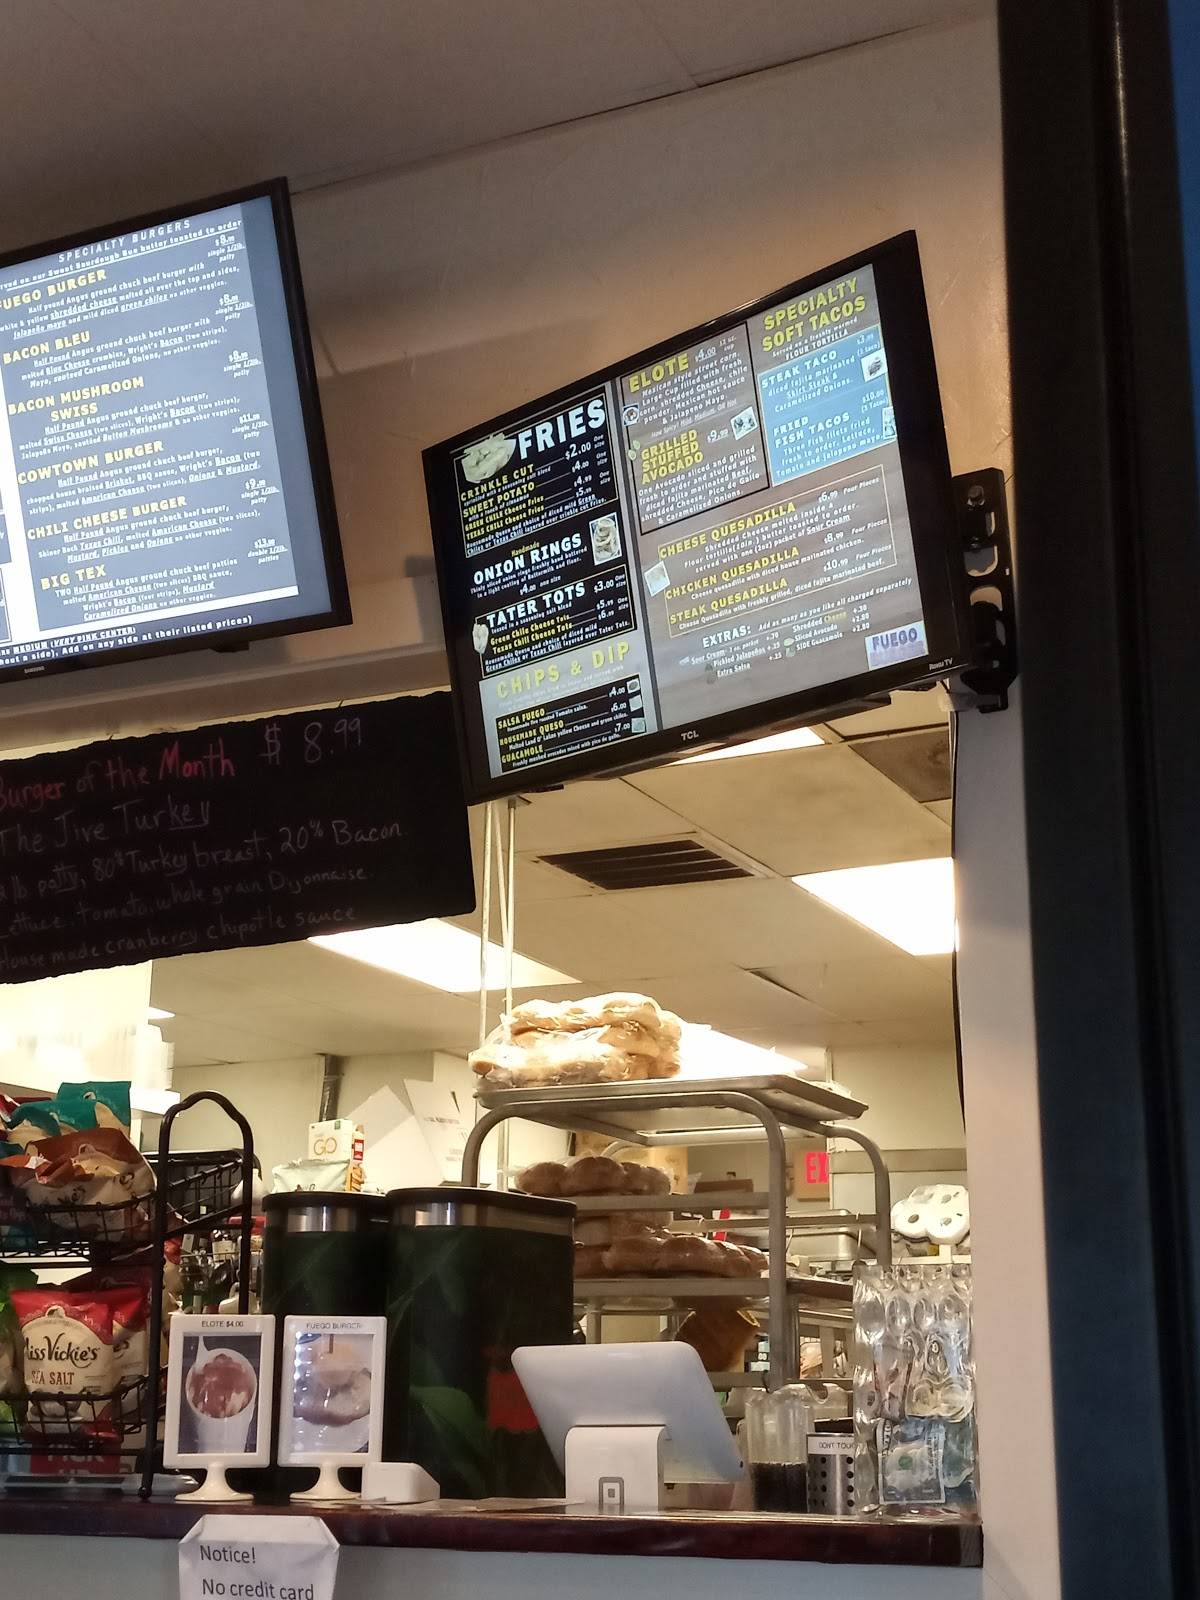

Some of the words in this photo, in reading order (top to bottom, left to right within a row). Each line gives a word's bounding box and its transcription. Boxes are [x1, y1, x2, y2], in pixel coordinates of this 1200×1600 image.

[59, 238, 124, 264] SPECIALTY
[132, 220, 190, 244] BURGERS
[0, 290, 41, 310] UEGO
[47, 270, 106, 296] BURGER
[765, 278, 856, 331] SPECIALTY
[762, 322, 803, 352] SOFT
[809, 296, 865, 333] TACOS
[812, 329, 848, 350] TORTILLA
[3, 342, 49, 365] BACON
[55, 331, 90, 351] BLEU
[630, 353, 688, 393] ELOTE
[642, 381, 671, 399] Mexican
[674, 371, 692, 385] style
[694, 360, 717, 376] street
[642, 394, 662, 407] Large
[665, 387, 678, 397] Cup
[681, 375, 701, 390] filled
[703, 368, 720, 381] with
[722, 358, 742, 373] fresh
[661, 388, 694, 408] shredded
[729, 366, 747, 379] chile
[762, 365, 800, 389] STEAK
[804, 350, 836, 371] TACO
[8, 396, 55, 416] BACON
[61, 376, 144, 404] MUSHROOM
[675, 393, 705, 411] Mexican
[708, 386, 720, 397] hot
[723, 376, 745, 391] sauce
[51, 402, 98, 423] SWISS
[519, 400, 605, 459] FRIES
[774, 417, 808, 438] FRIED
[775, 429, 804, 449] FISH
[809, 412, 849, 435] TACOS
[18, 455, 98, 485] COWTOWN
[105, 441, 163, 464] BURGER
[641, 430, 697, 461] GRILLED
[643, 441, 698, 473] STUFFED
[461, 475, 508, 502] CRINKLE
[513, 464, 533, 480] CUT
[565, 442, 591, 460] $2.00
[638, 487, 652, 497] One
[655, 474, 685, 491] Avocado
[688, 463, 710, 478] sliced
[713, 457, 726, 469] and
[729, 445, 755, 463] grilled
[639, 493, 658, 506] fresh
[661, 490, 668, 498] to
[671, 480, 690, 494] order
[694, 473, 707, 485] and
[710, 461, 737, 479] stuffed
[739, 454, 757, 467] with
[642, 452, 703, 486] AVOCADO
[463, 498, 493, 518] SWEET
[497, 482, 534, 505] POTATO
[646, 498, 665, 513] diced
[691, 474, 729, 495] marinated
[27, 521, 68, 540] CHILI
[74, 508, 127, 530] CHEESE
[132, 496, 186, 517] BURGER
[658, 534, 706, 561] CHEESE
[711, 502, 795, 542] QUESADILLA
[41, 573, 70, 590] BIG
[75, 564, 106, 582] TEX
[474, 555, 524, 585] ONION
[530, 533, 581, 565] RINGS
[664, 575, 717, 601] CHICKEN
[722, 547, 799, 581] QUESADILLA
[487, 600, 537, 628] TATER
[543, 582, 585, 609] TOTS
[594, 579, 614, 594] $3.00
[670, 604, 706, 625] STEAK
[711, 578, 787, 611] QUESADILLA
[62, 645, 79, 655] Add
[83, 644, 94, 652] on
[98, 640, 114, 649] any
[118, 636, 138, 646] side
[142, 633, 152, 642] at
[155, 629, 180, 639] their
[183, 622, 212, 634] listed
[490, 635, 510, 646] Green
[512, 627, 529, 639] Chile
[530, 619, 555, 633] Cheese
[556, 614, 570, 624] Tots
[703, 625, 751, 648] EXTRAS:
[871, 623, 919, 656] FUEGO
[498, 662, 559, 698] CHIPS
[571, 658, 582, 676] &
[591, 638, 631, 670] DIP
[498, 716, 520, 730] SALSA
[522, 708, 545, 723] FUEGO
[681, 730, 699, 740] TCL
[76, 761, 101, 793] of
[105, 757, 150, 789] the
[158, 741, 236, 781] Month
[502, 745, 543, 764] GUACAMOLE
[53, 808, 108, 851] Jive
[112, 798, 210, 832] Turkey
[330, 819, 404, 849] Bacon
[294, 904, 358, 925] sauce
[805, 1152, 829, 1184] EX
[201, 1320, 224, 1328] ELOTE
[43, 1332, 100, 1369] Vickie's
[49, 1371, 75, 1385] SALT
[200, 1545, 256, 1564] Notice!
[202, 1578, 225, 1596] No
[230, 1581, 276, 1599] credit
[279, 1583, 314, 1600] card
